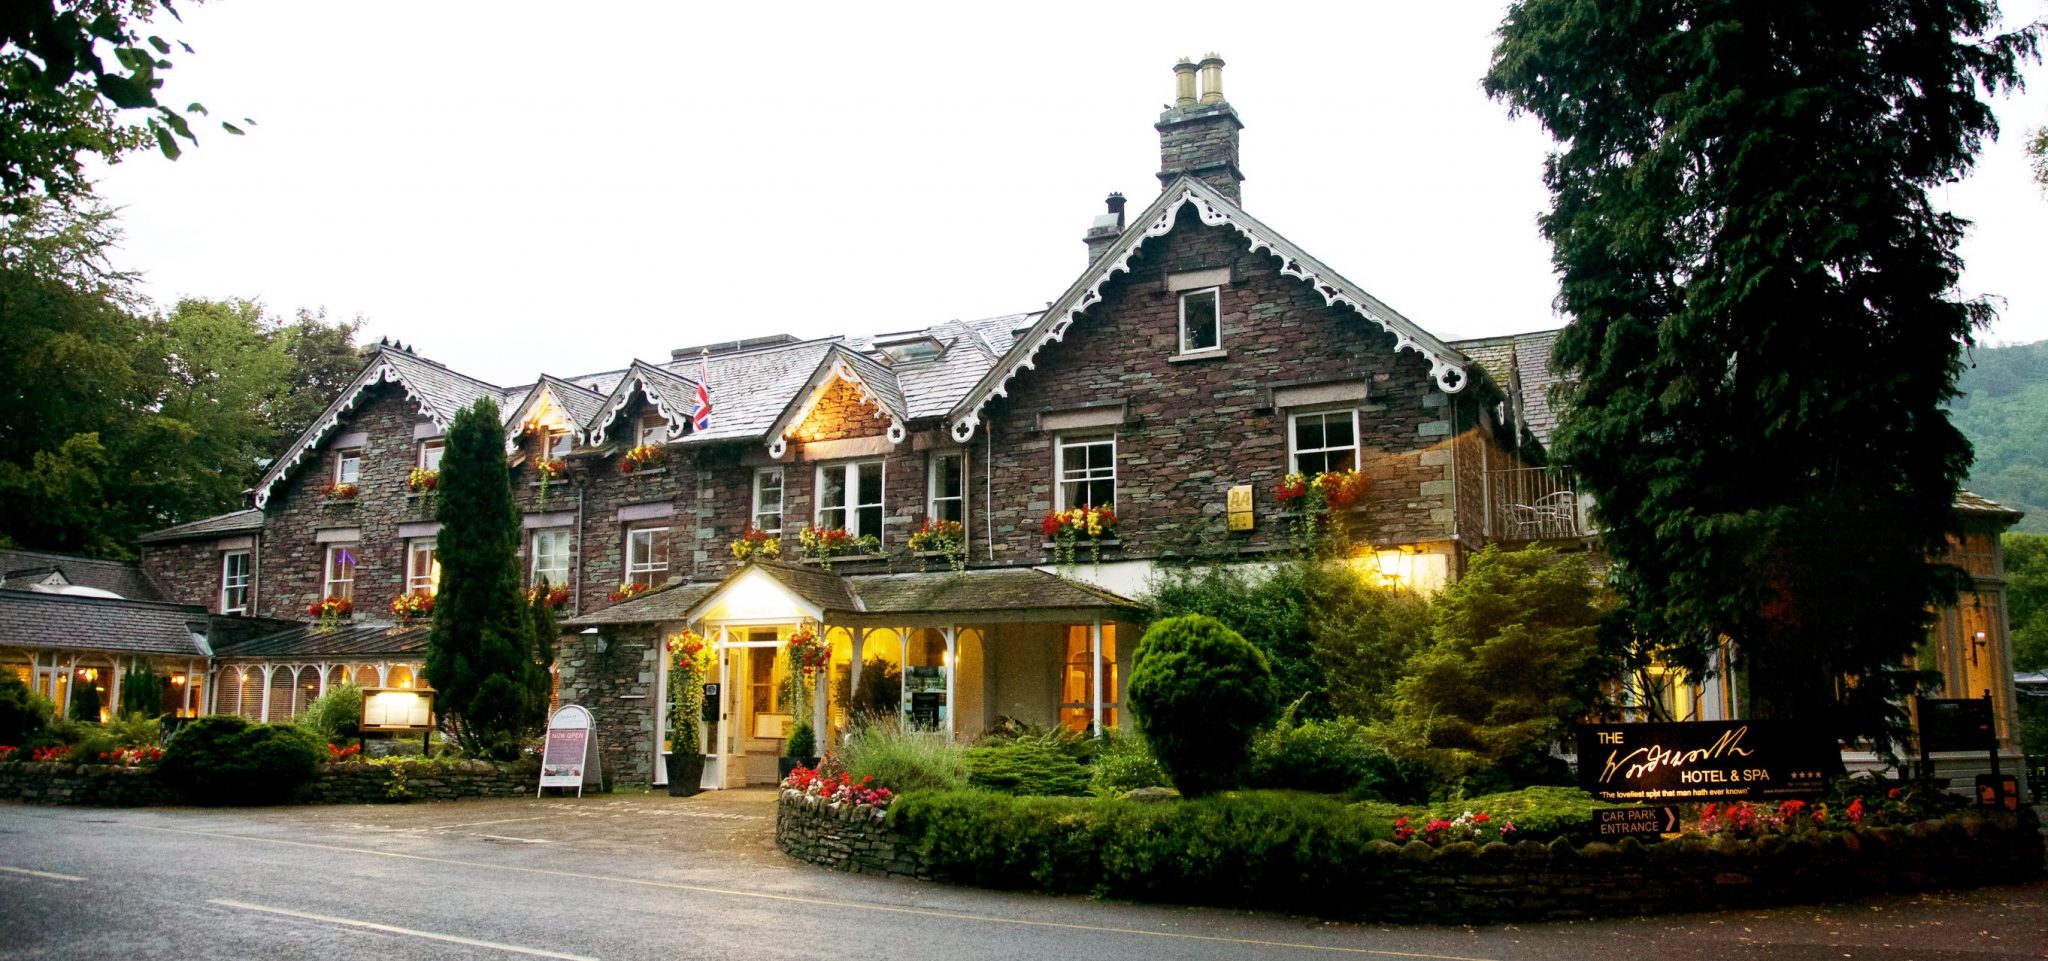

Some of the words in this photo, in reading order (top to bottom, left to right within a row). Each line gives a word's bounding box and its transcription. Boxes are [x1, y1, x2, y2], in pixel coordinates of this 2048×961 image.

[1597, 732, 1624, 744] THE
[1599, 725, 1754, 783] Wordsworth
[1681, 770, 1728, 783] HOTEL
[1730, 769, 1740, 782] &
[1743, 769, 1770, 781] SPA
[1616, 790, 1645, 798] loveliest
[1646, 790, 1661, 799] spot
[1661, 789, 1676, 798] that
[1692, 788, 1708, 797] hath
[1602, 811, 1625, 822] CAR
[1628, 809, 1656, 820] PARK
[1600, 821, 1660, 834] ENTRANCE
